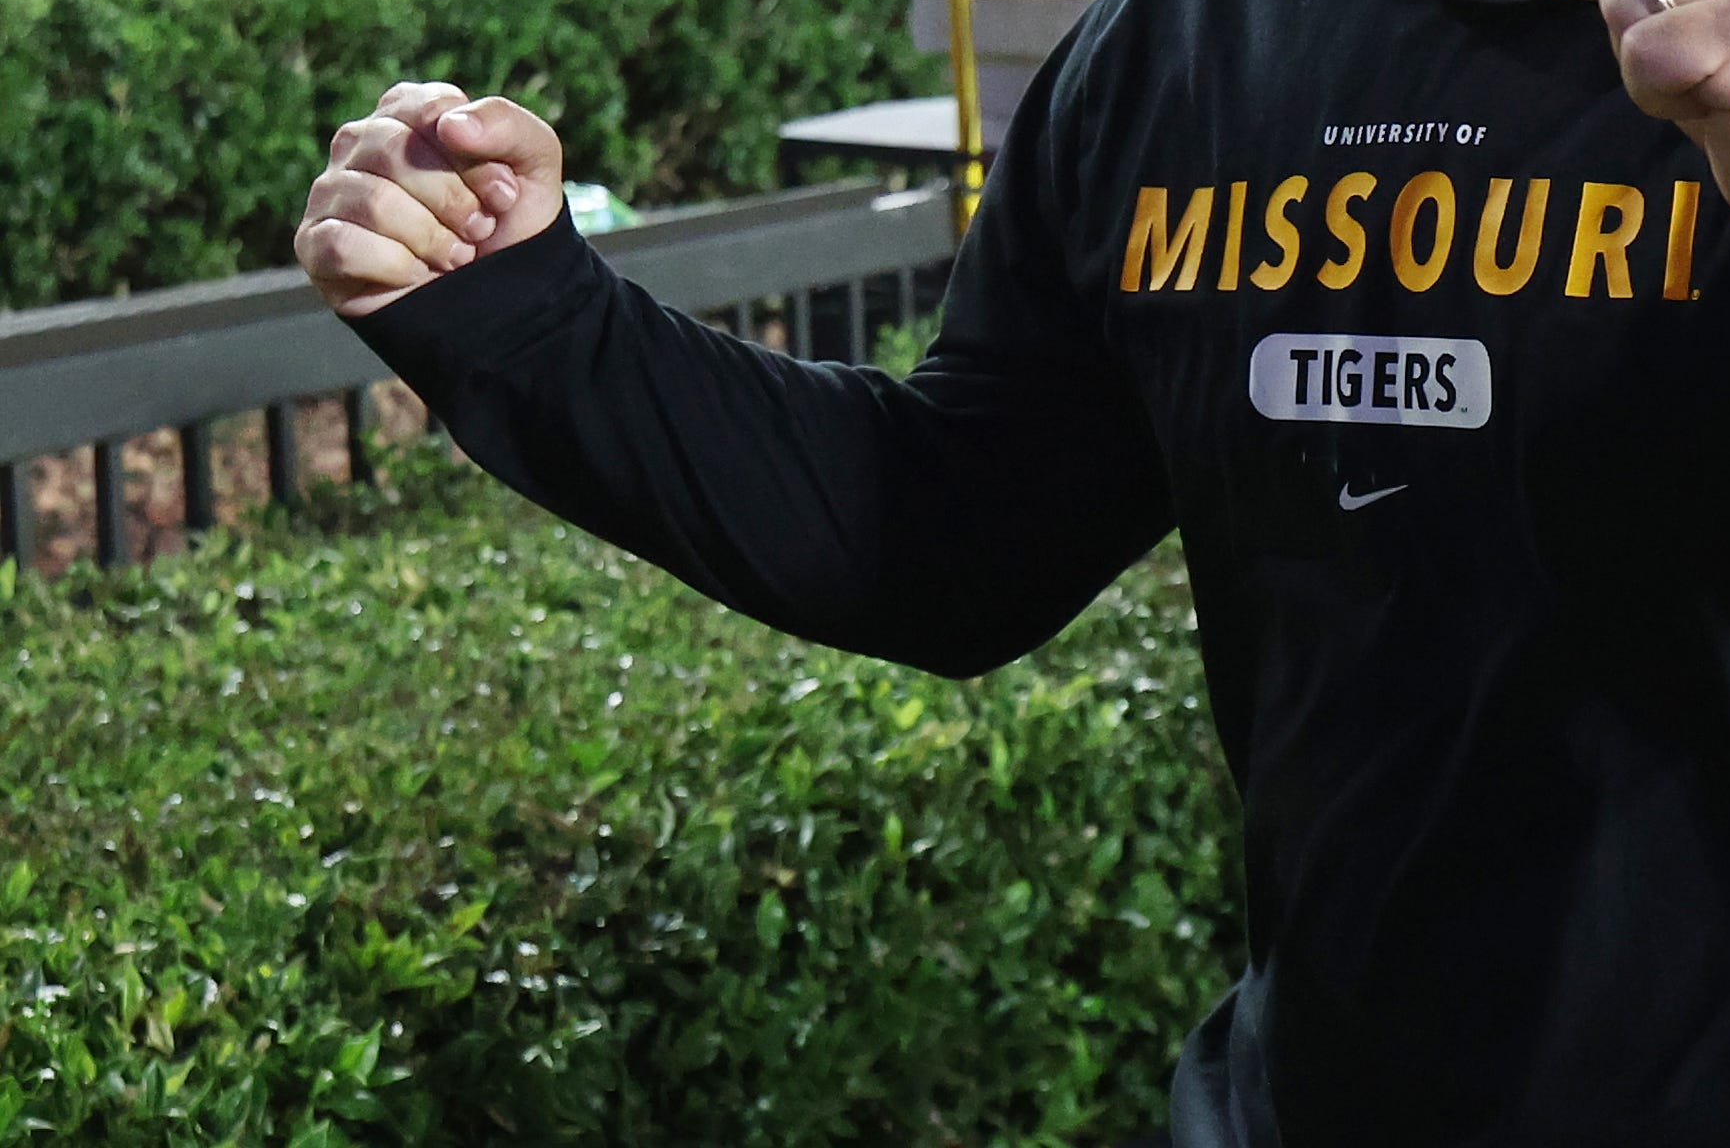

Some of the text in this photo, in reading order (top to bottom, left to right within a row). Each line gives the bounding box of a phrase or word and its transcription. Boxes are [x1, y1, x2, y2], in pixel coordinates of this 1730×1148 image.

[1323, 122, 1487, 145] UNIVERSITY OF
[1119, 170, 1701, 301] MISSOURI
[1289, 348, 1458, 413] TIGERS
